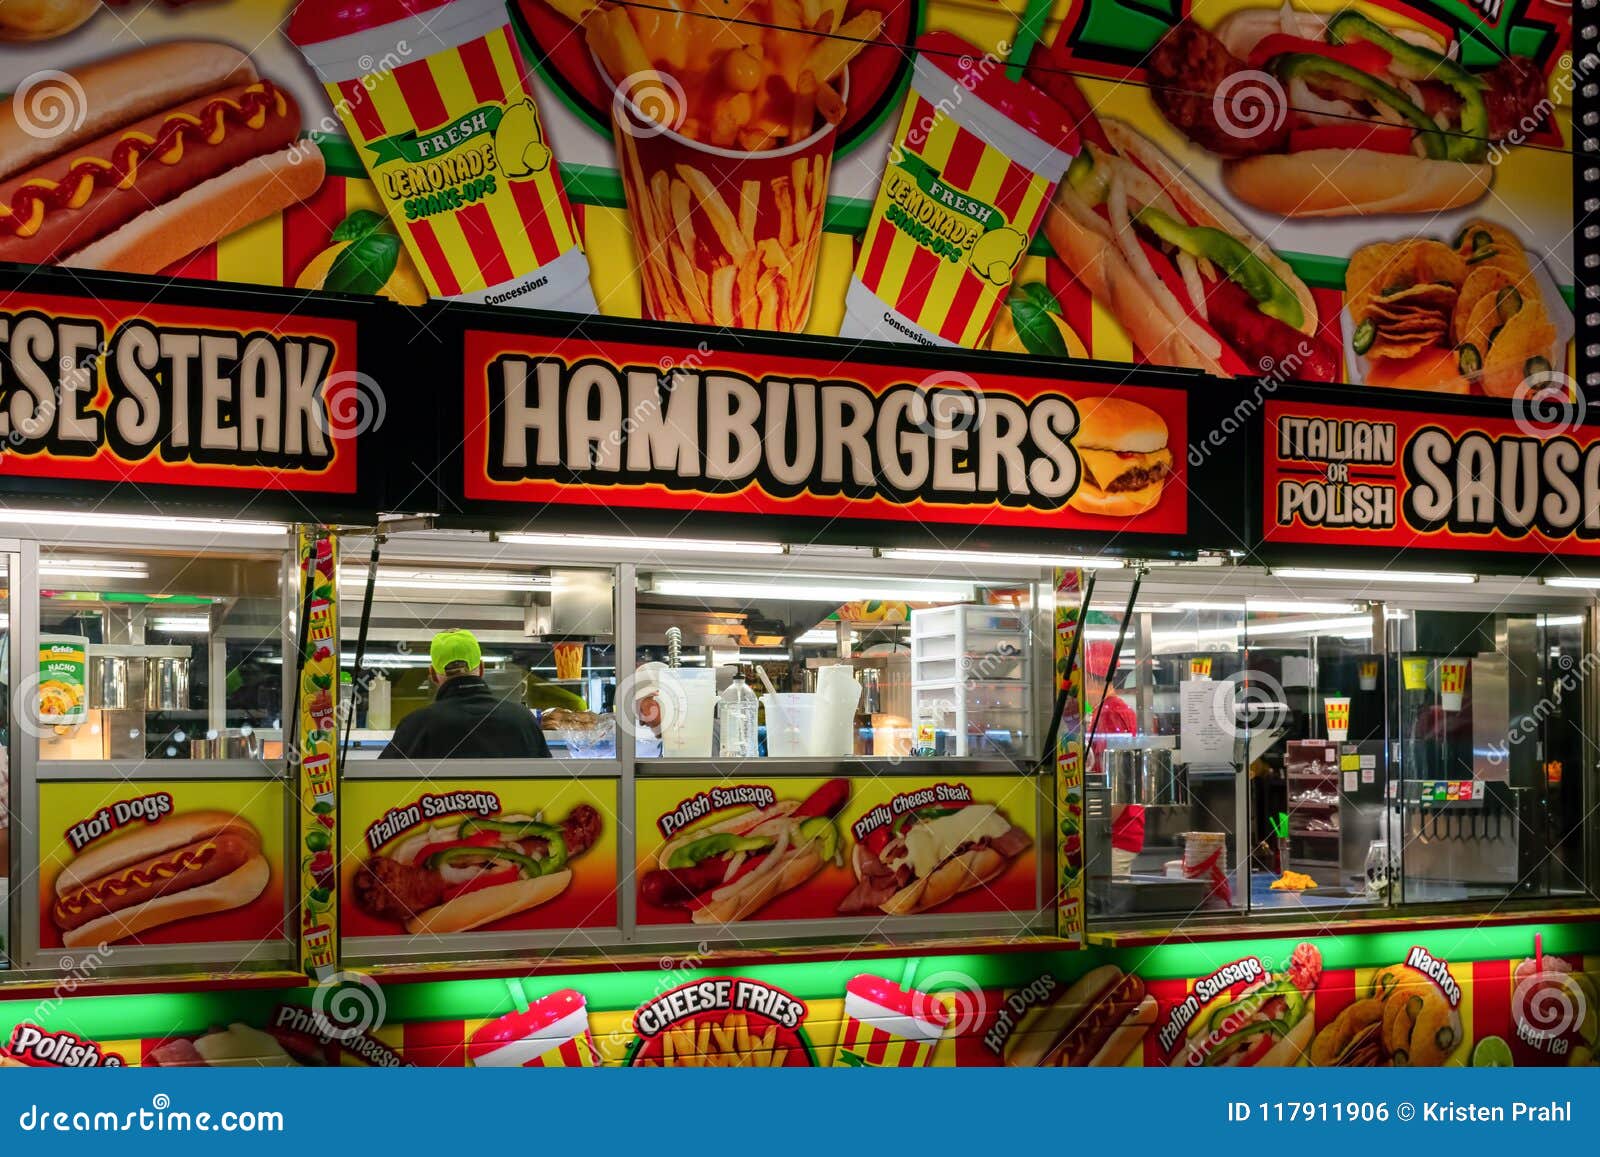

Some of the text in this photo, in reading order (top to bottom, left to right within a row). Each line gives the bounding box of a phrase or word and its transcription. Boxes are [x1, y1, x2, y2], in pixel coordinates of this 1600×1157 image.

[416, 112, 488, 157] FRESH
[383, 144, 497, 200] LEMONADE
[403, 174, 497, 219] SHAKE-UPS
[887, 174, 978, 250] LEMONADE
[928, 182, 993, 223] FRESH
[885, 204, 963, 263] SHAKE-UPS
[484, 275, 549, 306] Concessions
[0, 316, 329, 457] SE STEAK
[501, 358, 1078, 498] HAMBURGERS
[1281, 418, 1395, 463] ITALIAN
[1327, 464, 1349, 483] OR
[1282, 483, 1395, 526] POLISH
[70, 794, 170, 848] Hot Dogs
[368, 793, 499, 849] Italian Sausage
[661, 787, 774, 836] Polish Sausage
[855, 785, 971, 840] Philly Cheese Steak
[1407, 947, 1460, 1006] Nachos
[638, 981, 804, 1035] CHEESE FRIES
[984, 974, 1056, 1054] Hot Dogs
[1159, 957, 1262, 1051] Italian Sausage
[15, 1027, 98, 1067] Polish
[276, 1006, 400, 1067] Philly Cheese
[1517, 1016, 1569, 1055] Iced Tea
